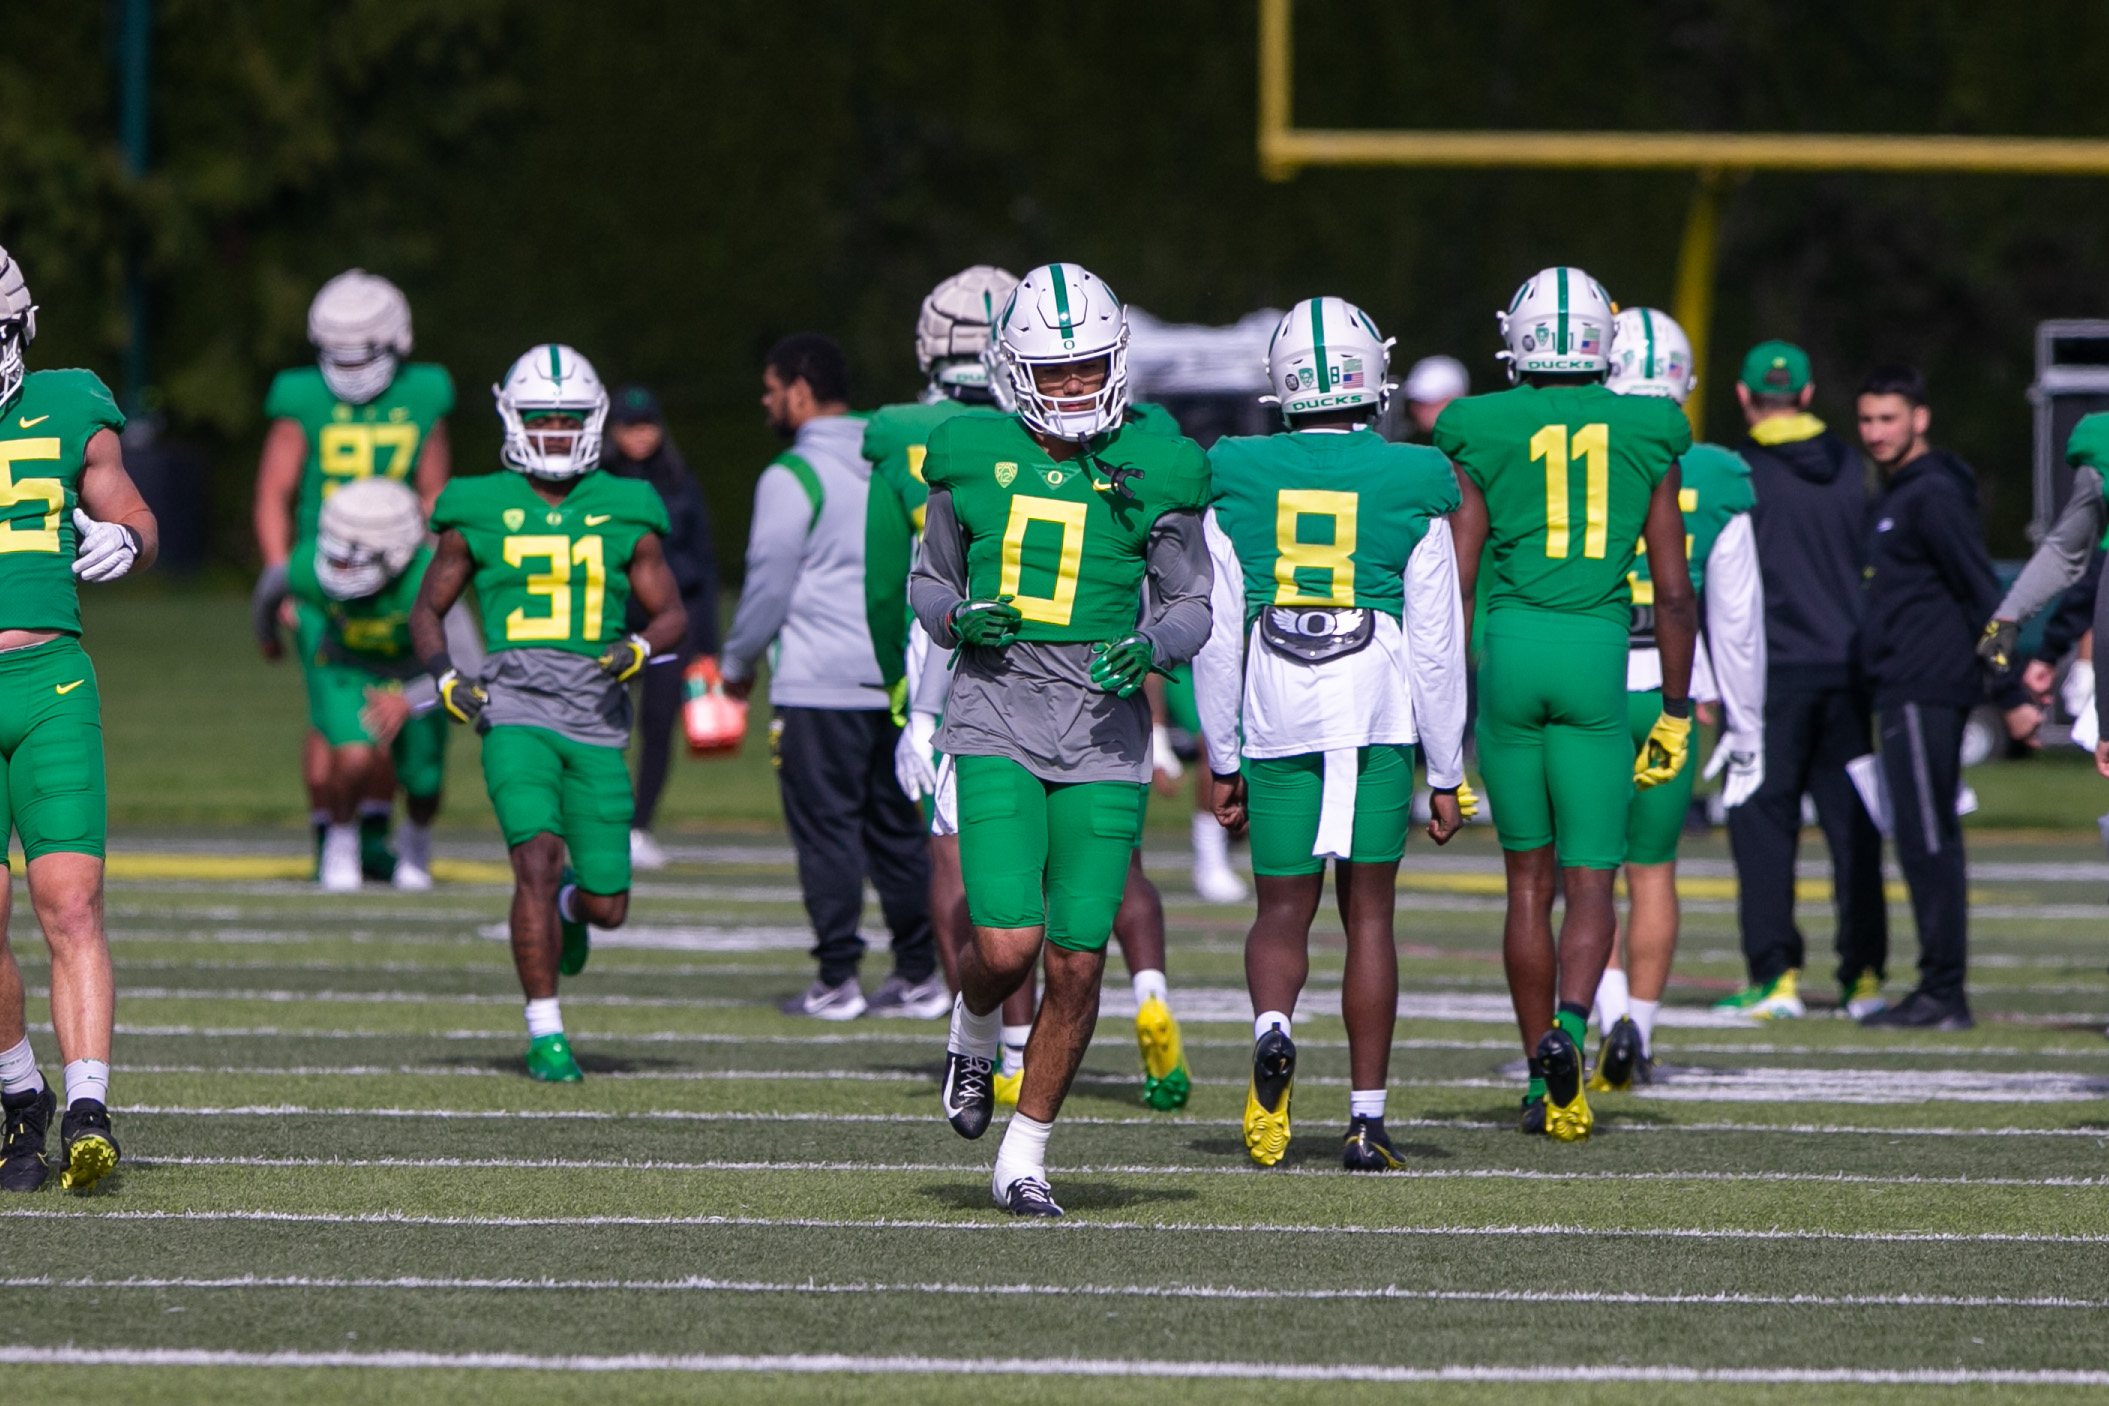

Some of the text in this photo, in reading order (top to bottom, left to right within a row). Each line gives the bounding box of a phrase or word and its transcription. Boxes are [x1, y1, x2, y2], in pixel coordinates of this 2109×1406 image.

[1292, 395, 1363, 411] DUCKS
[1330, 366, 1340, 384] 8
[1528, 361, 1595, 369] DUCKS
[320, 423, 419, 498] 97
[1530, 423, 1609, 559] 11
[503, 535, 605, 641] 31
[998, 494, 1088, 627] 0
[1274, 489, 1359, 607] 8
